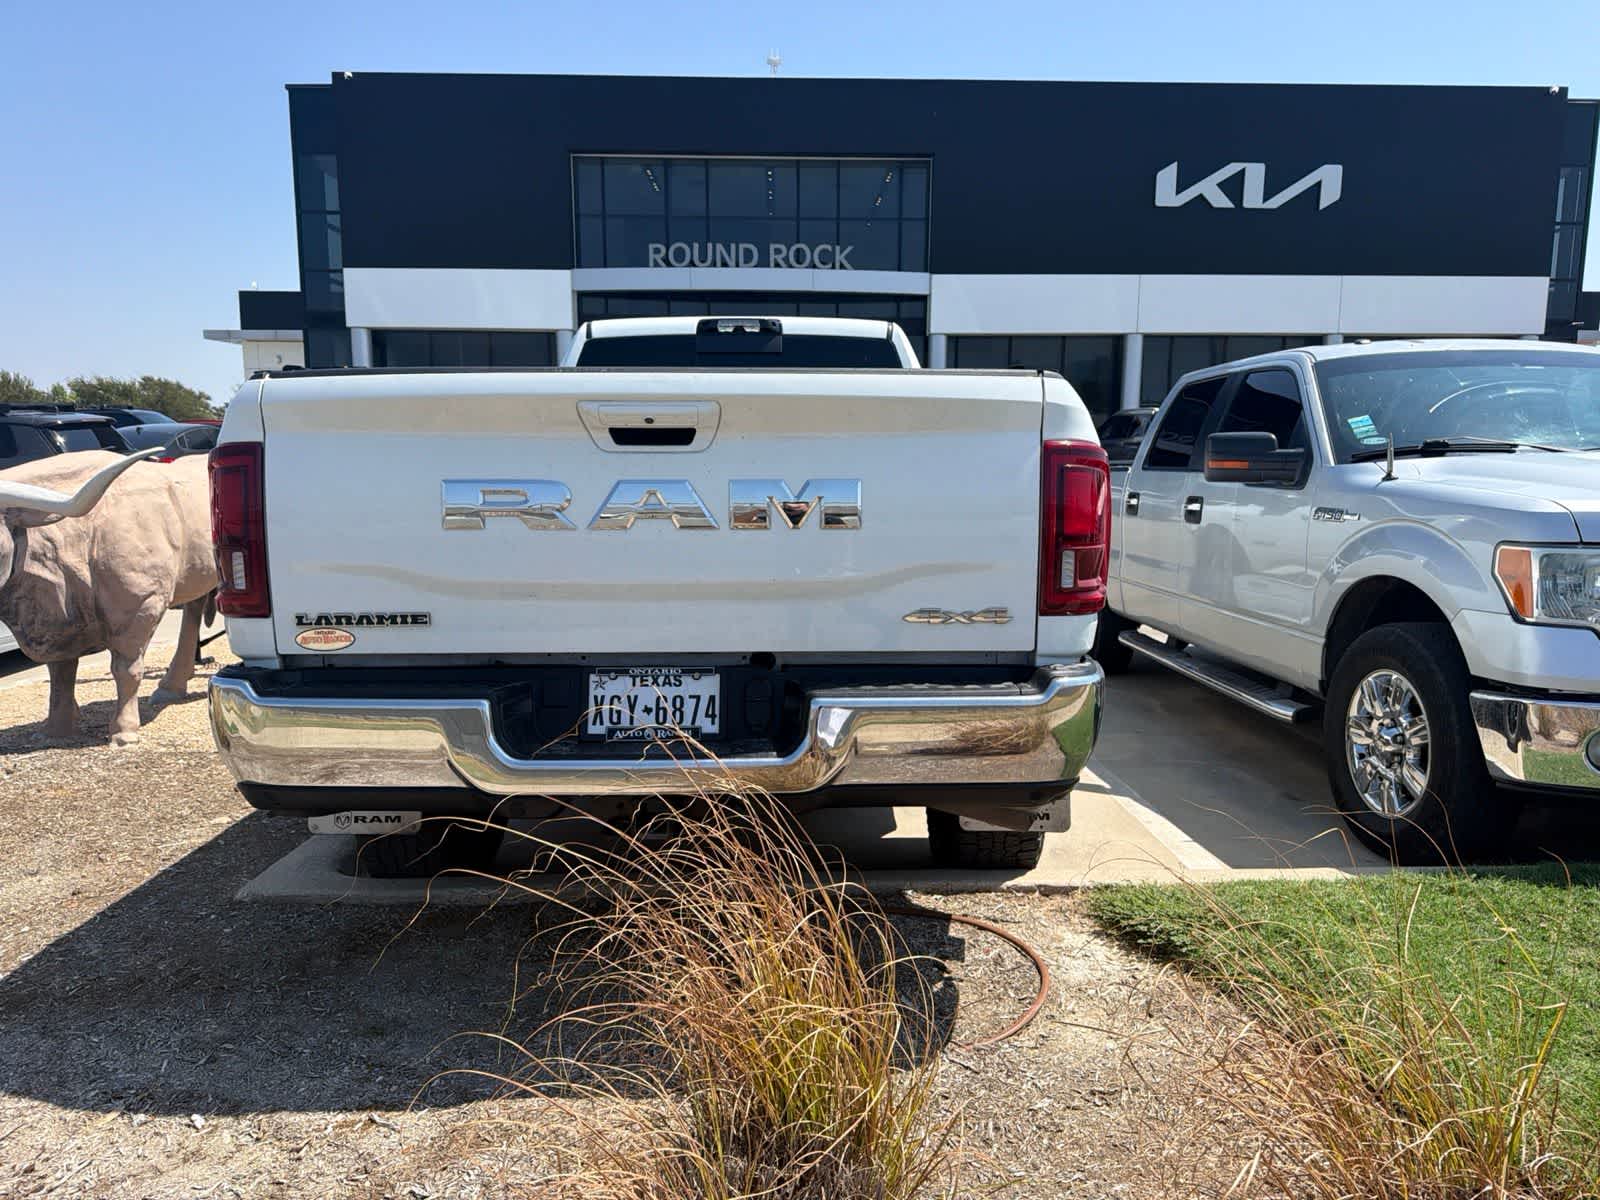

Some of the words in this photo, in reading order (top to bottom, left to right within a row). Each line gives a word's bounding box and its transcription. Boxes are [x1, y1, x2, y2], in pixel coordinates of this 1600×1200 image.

[1155, 161, 1343, 211] KIA
[648, 242, 759, 268] ROUND
[769, 243, 855, 270] ROCK
[440, 478, 863, 530] RAM
[295, 612, 431, 627] LARAMIE
[630, 674, 682, 687] TEXAS
[614, 729, 643, 739] AUTO
[353, 815, 402, 824] RAM
